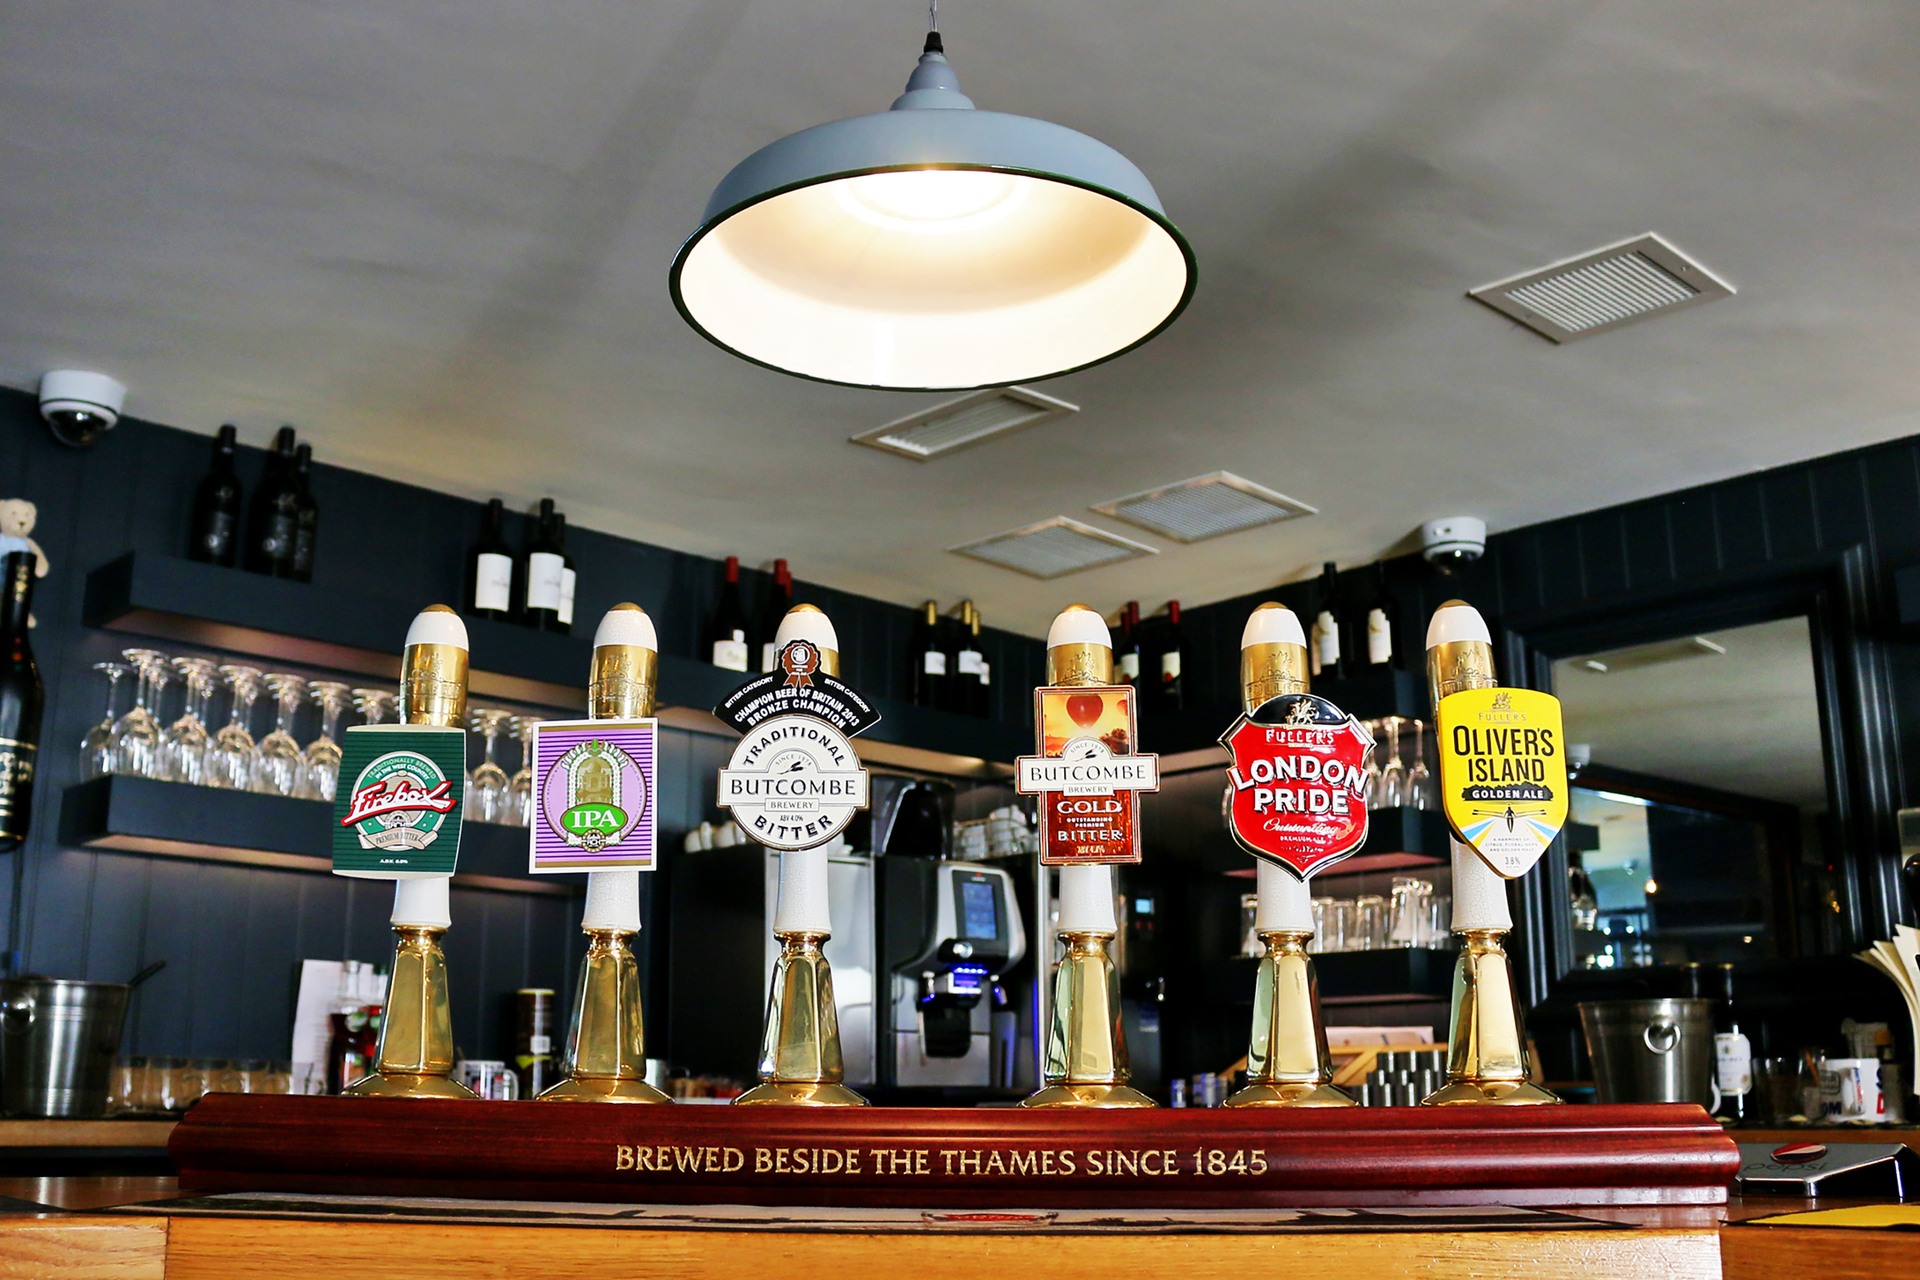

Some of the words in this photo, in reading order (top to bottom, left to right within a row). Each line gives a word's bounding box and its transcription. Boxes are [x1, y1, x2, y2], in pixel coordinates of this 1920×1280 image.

[725, 691, 744, 708] BITTER
[742, 676, 774, 694] CATEGORY
[824, 678, 845, 692] BITTER
[844, 688, 871, 713] CATEGORY
[734, 692, 775, 722] CHAMPION
[775, 688, 798, 700] BEER
[799, 687, 812, 698] OF
[811, 690, 845, 712] BRITAIN
[841, 707, 860, 727] 2013
[747, 699, 789, 727] BRONZE
[792, 698, 847, 729] CHAMPION
[742, 726, 845, 767] TRADITIONAL
[1265, 728, 1335, 745] FULLER'S
[1453, 725, 1555, 757] OLIVER'S
[367, 757, 415, 778] TRADITIONALLY
[415, 760, 437, 779] BREWED
[775, 753, 795, 766] SINCE
[1468, 758, 1545, 783] ISLAND
[1030, 765, 1146, 782] BUTCOMBE
[1230, 755, 1370, 795] LONDON
[731, 778, 857, 796] BUTCOMBE
[1068, 785, 1109, 793] BREWERY
[1471, 789, 1522, 799] GOLDEN
[1523, 789, 1544, 799] ALE
[340, 780, 457, 827] Firebox
[770, 801, 814, 809] BREWERY
[1056, 800, 1123, 814] GOLD
[1253, 788, 1350, 814] PRIDE
[571, 810, 620, 828] IPA
[754, 814, 834, 840] BITTER
[376, 832, 400, 845] PREMIUM
[1058, 829, 1123, 842] BITTER
[615, 1144, 745, 1173] BREWED
[754, 1147, 862, 1174] BESIDE
[869, 1148, 931, 1175] THE
[939, 1148, 1076, 1176] THAMES
[1086, 1149, 1180, 1177] SINCE
[1192, 1146, 1269, 1176] 1845
[1743, 1161, 1828, 1172] pepsi
